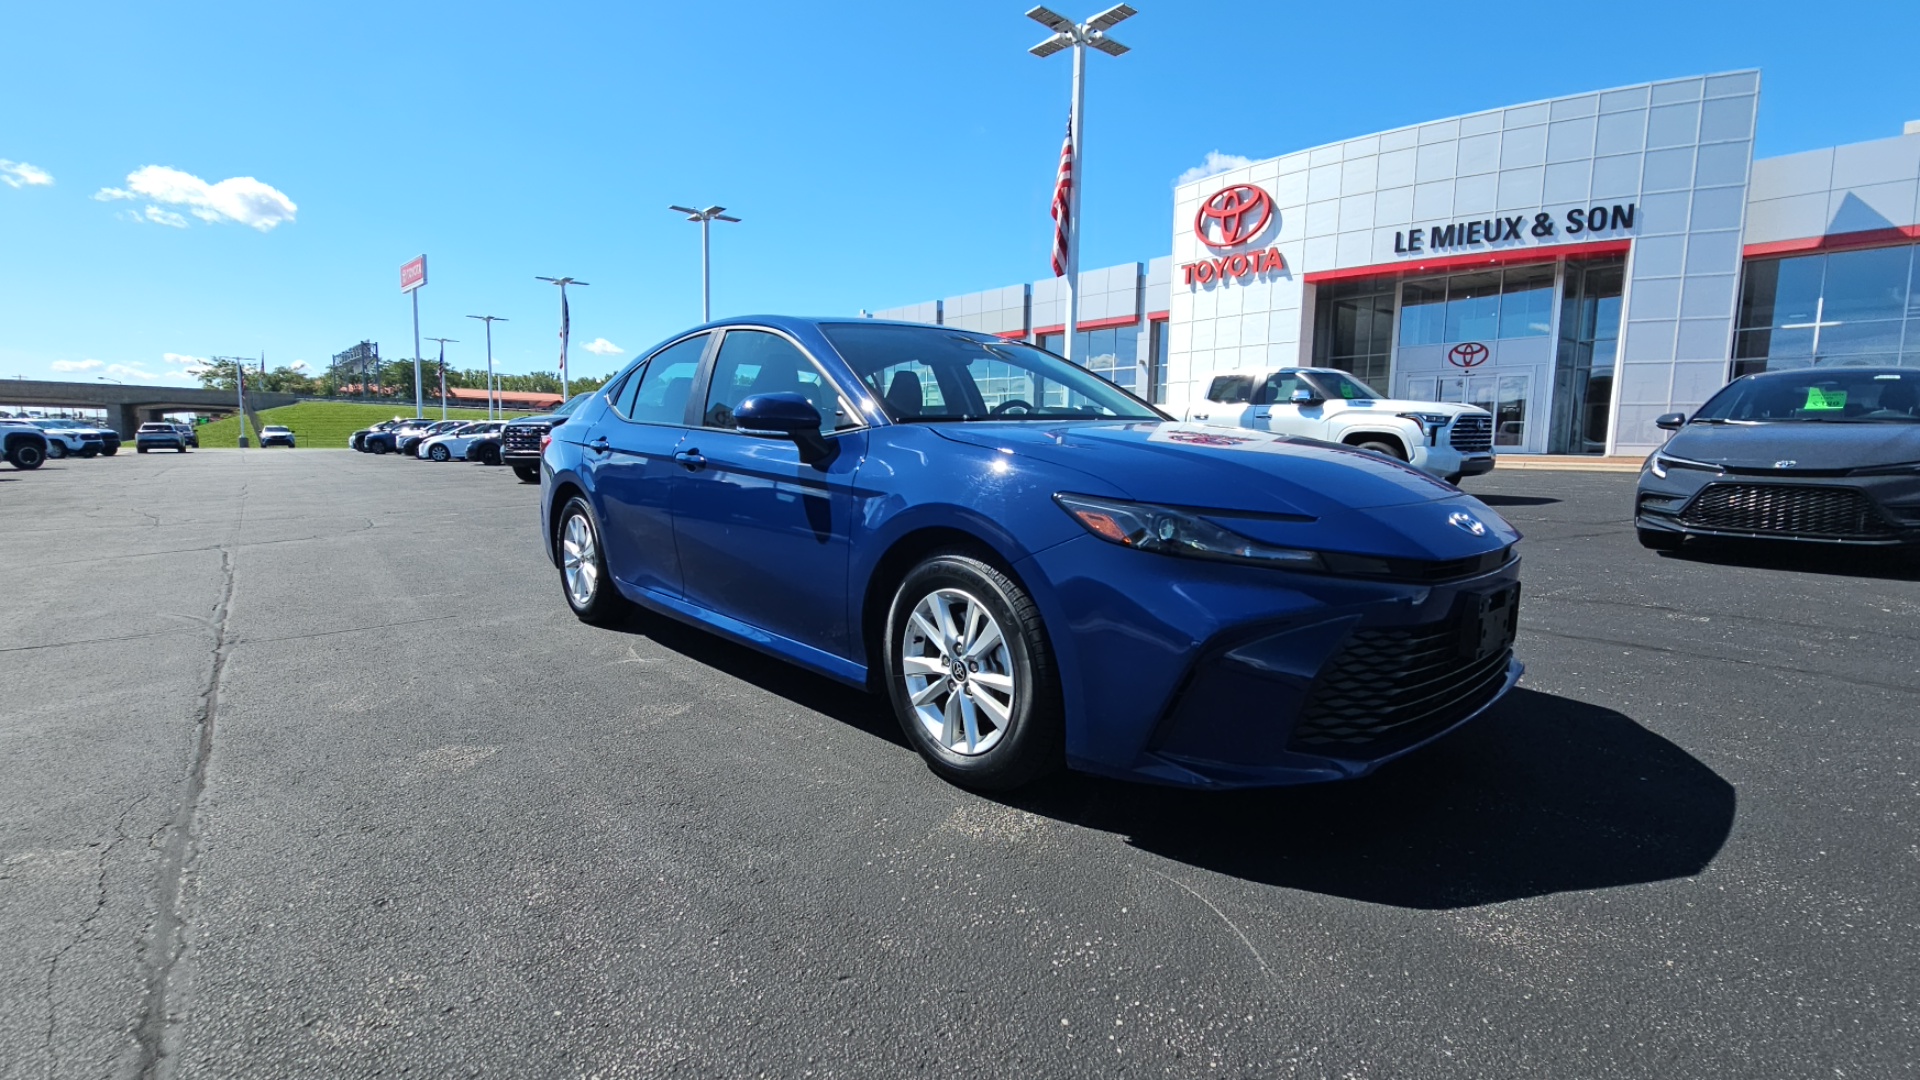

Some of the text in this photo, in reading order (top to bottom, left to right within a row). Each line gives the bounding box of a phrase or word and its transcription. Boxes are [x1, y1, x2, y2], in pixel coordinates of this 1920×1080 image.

[1394, 203, 1635, 253] LE MIEUX & SON
[406, 263, 422, 280] TOYOTA
[1181, 247, 1283, 285] TOYOTA
